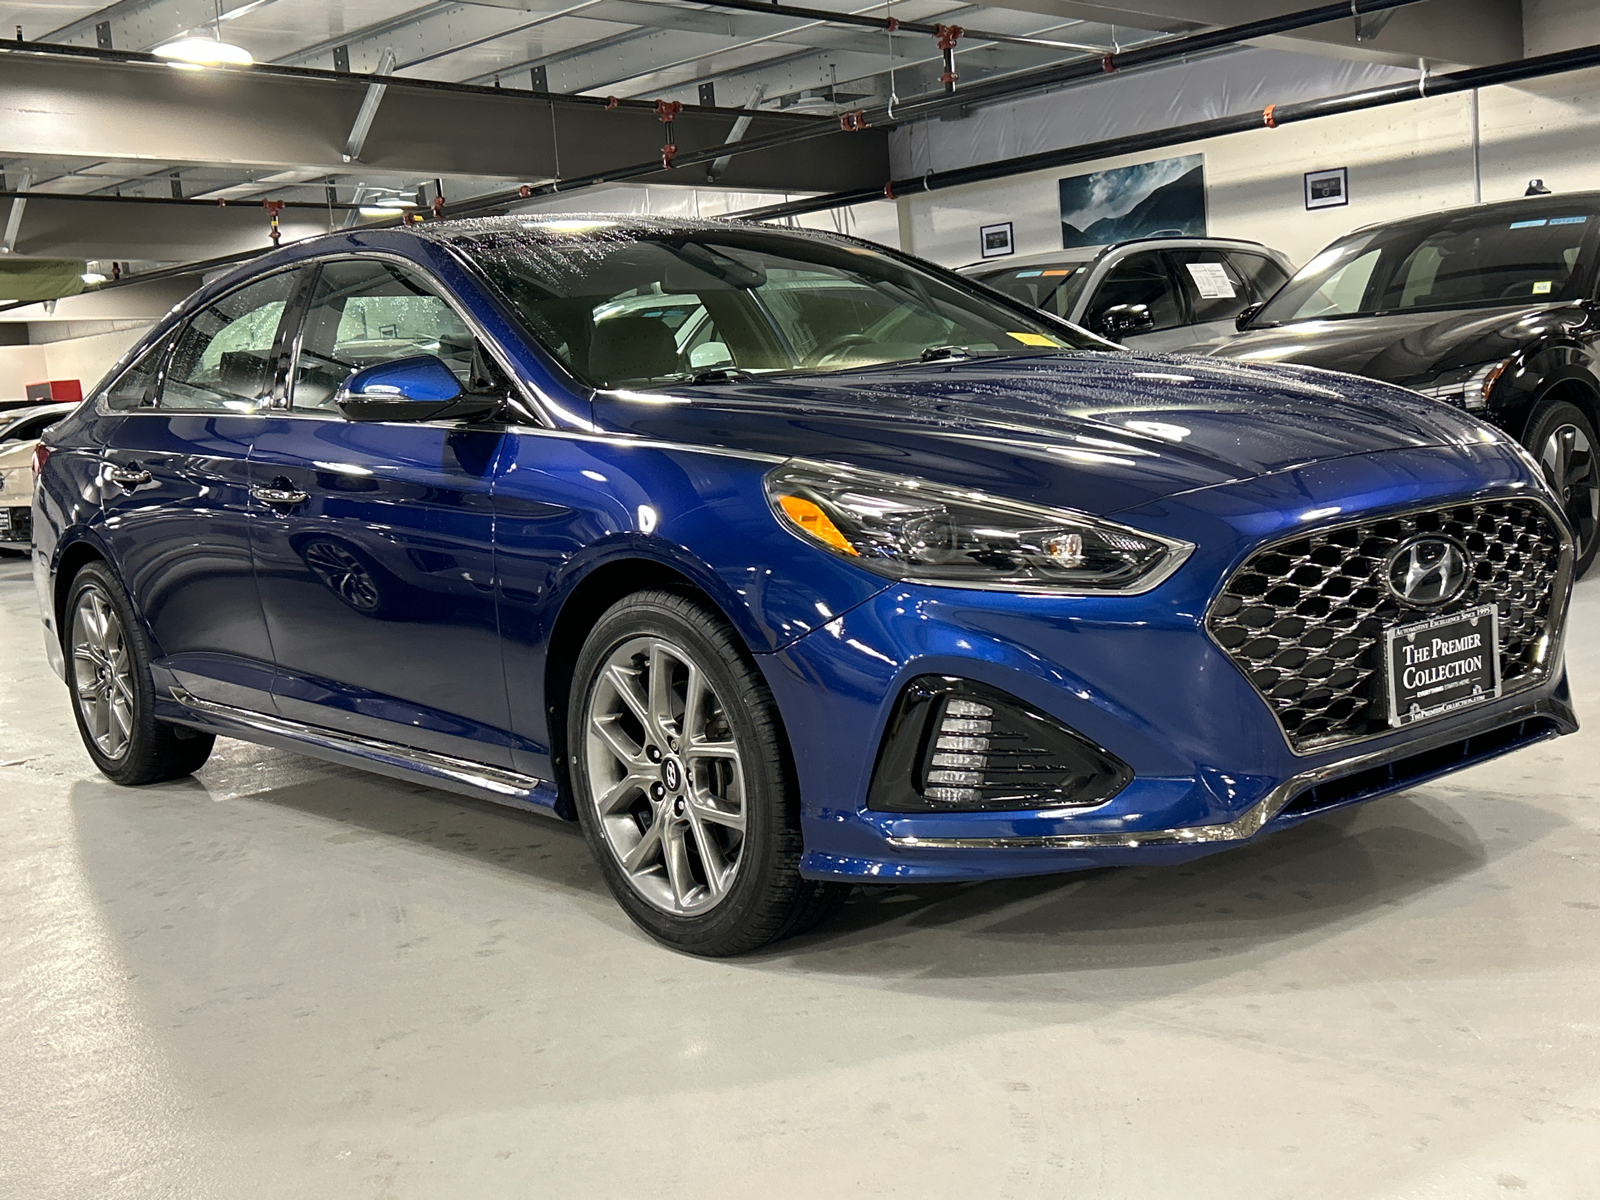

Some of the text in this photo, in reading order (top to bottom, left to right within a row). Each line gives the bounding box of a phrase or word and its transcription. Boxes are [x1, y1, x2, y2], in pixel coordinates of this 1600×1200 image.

[1402, 633, 1482, 666] THE PREMIER
[1402, 655, 1482, 690] COLLECTION
